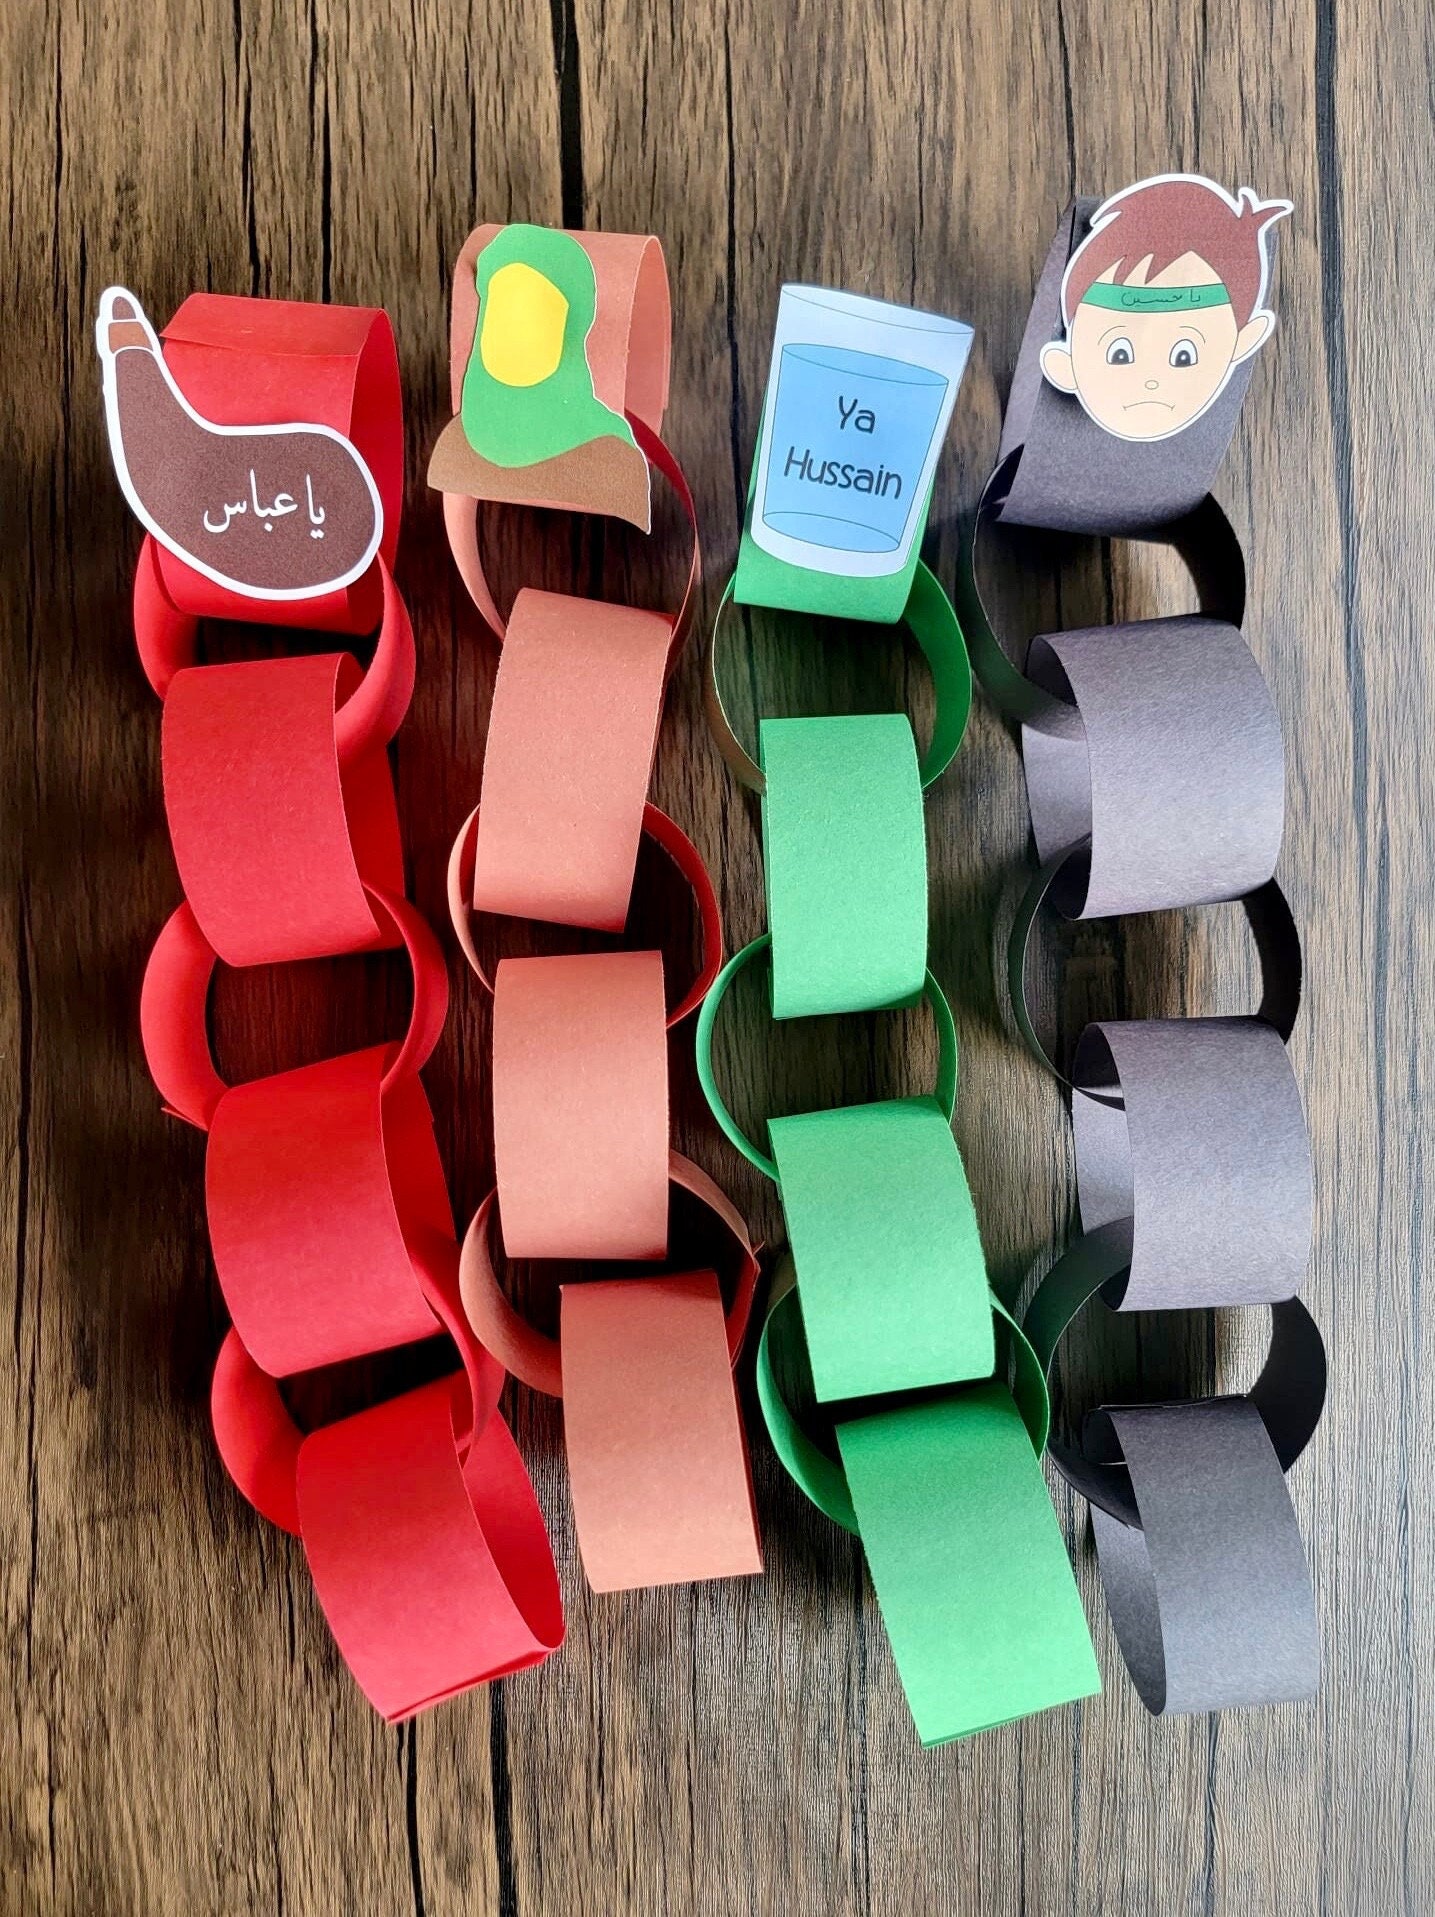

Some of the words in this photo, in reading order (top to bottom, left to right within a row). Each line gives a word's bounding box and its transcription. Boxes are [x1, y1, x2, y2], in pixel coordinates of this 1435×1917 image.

[1121, 291, 1183, 308] حسين
[1190, 288, 1201, 307] يا
[838, 395, 876, 434] Ya
[783, 446, 902, 500] Hussain
[203, 468, 298, 533] عباس
[305, 473, 326, 539] يا
